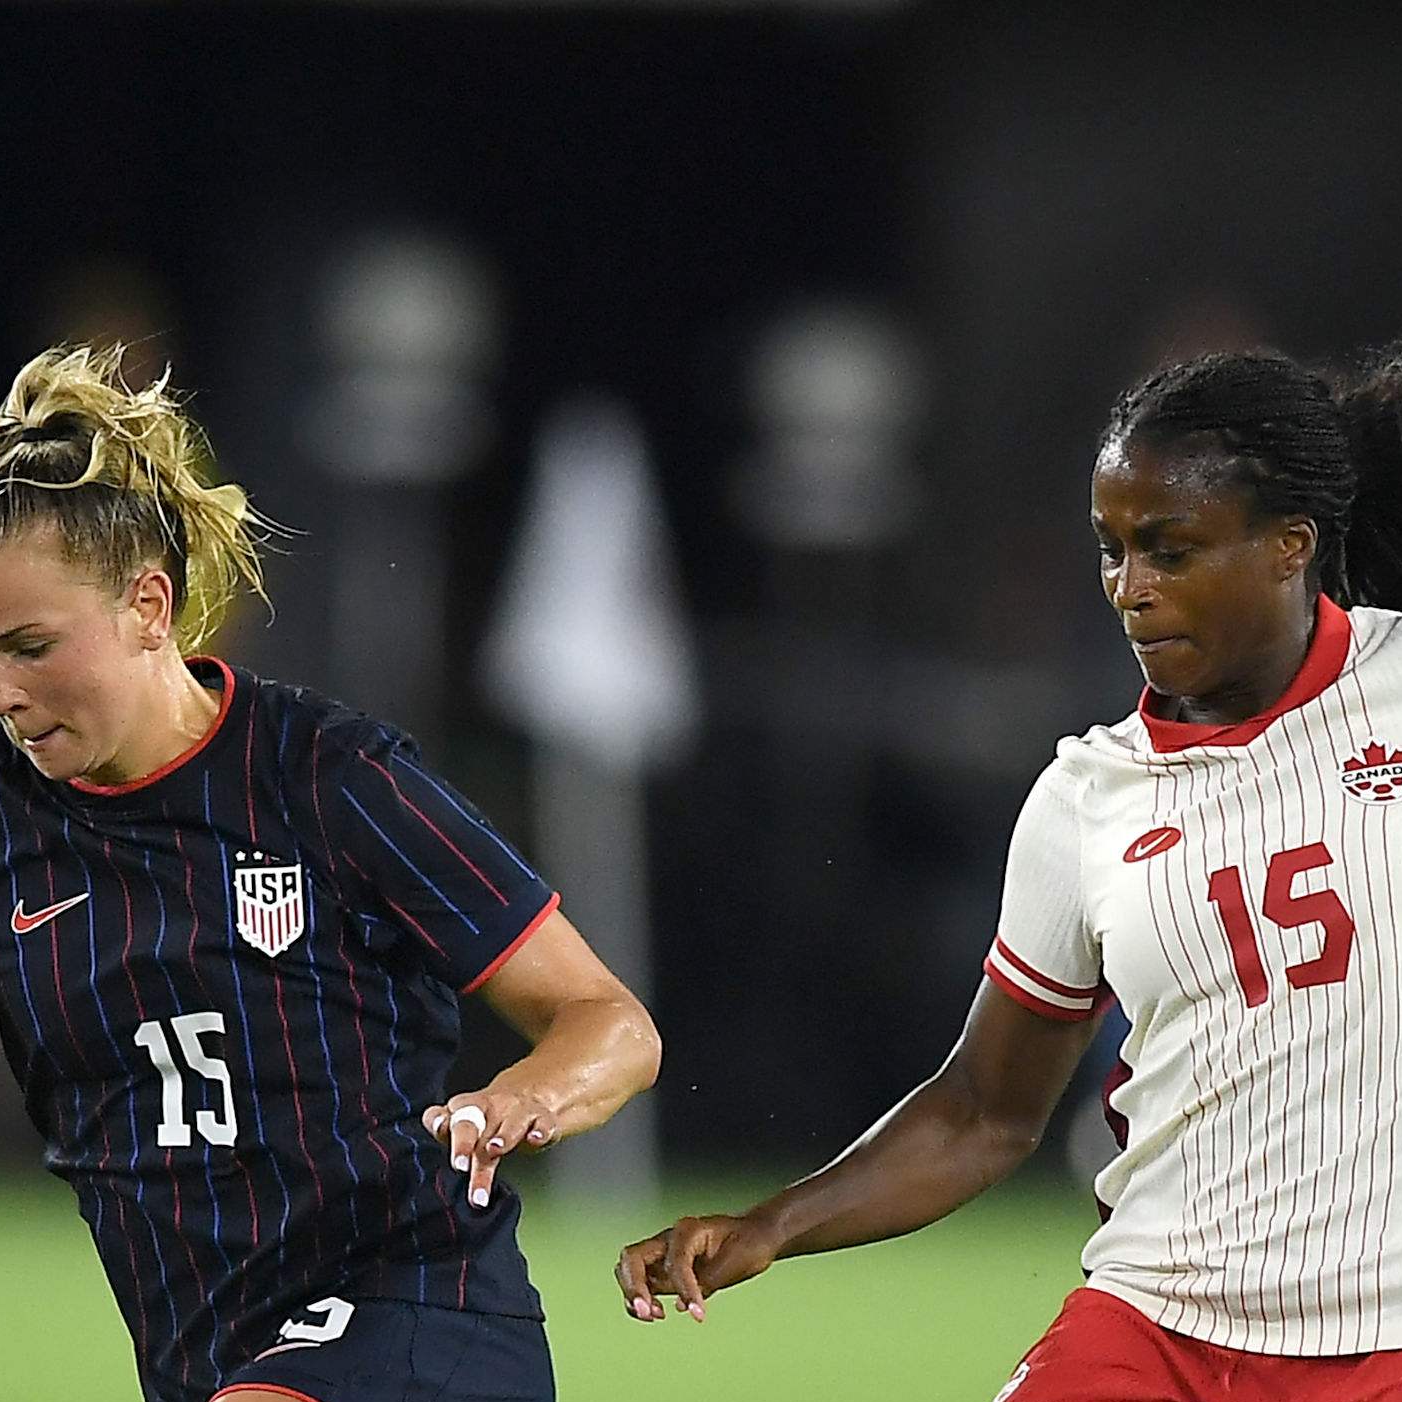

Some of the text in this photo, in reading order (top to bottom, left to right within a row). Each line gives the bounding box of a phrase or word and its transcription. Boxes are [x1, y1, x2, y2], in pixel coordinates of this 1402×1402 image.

[241, 871, 297, 905] USA
[1207, 841, 1355, 1008] 15
[134, 1011, 238, 1147] 15
